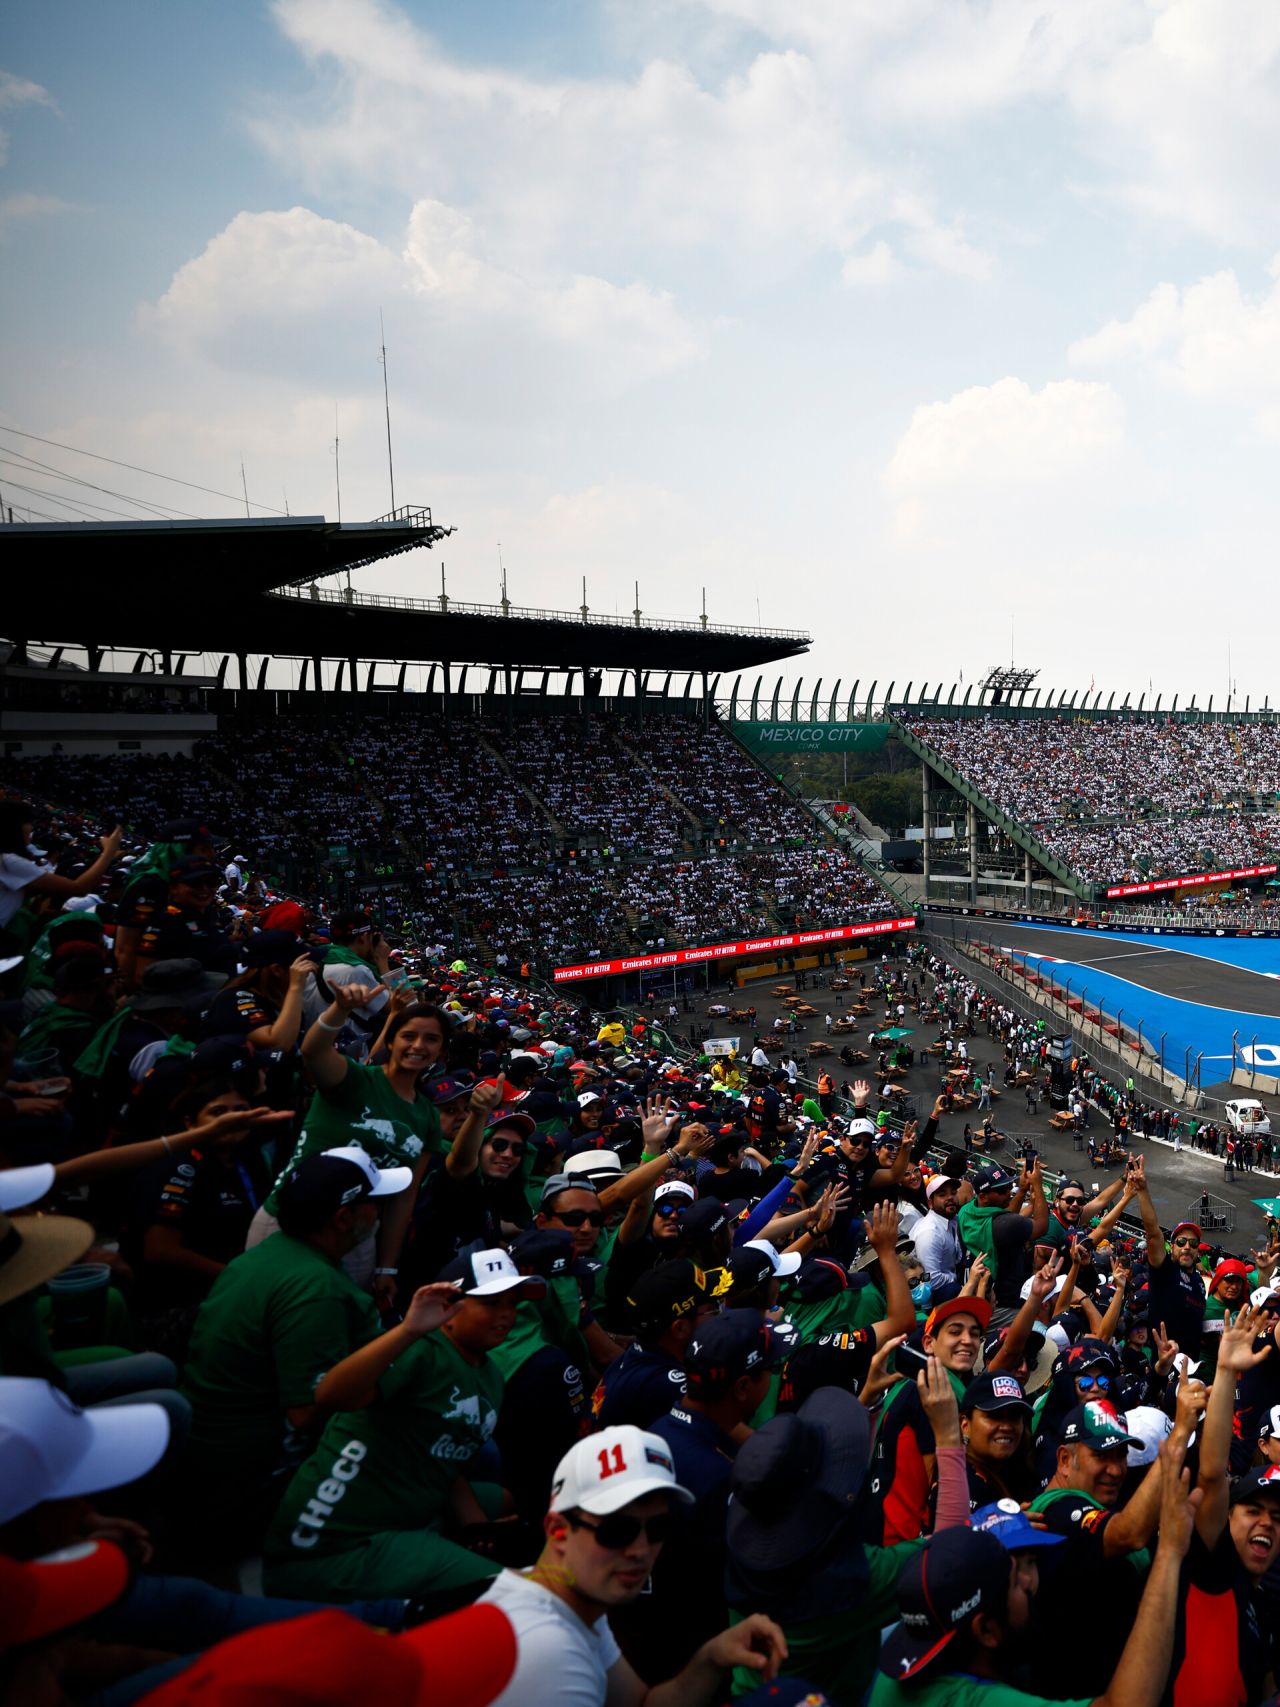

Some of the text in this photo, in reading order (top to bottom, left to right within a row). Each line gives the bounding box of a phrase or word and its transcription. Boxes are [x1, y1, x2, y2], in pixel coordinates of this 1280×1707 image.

[759, 728, 864, 742] MEXICO CITY
[800, 934, 823, 942] Emirates
[685, 951, 712, 959] Emirates
[722, 946, 736, 954] BETTER
[746, 942, 771, 950] Emirates
[594, 964, 610, 973] BETTER
[622, 960, 652, 969] Emirates
[662, 955, 677, 963] BETTER
[486, 1261, 503, 1272] 11
[671, 1296, 696, 1317] 1ST
[1093, 1413, 1108, 1427] 11
[597, 1444, 627, 1480] 11
[951, 1588, 983, 1623] telcel
